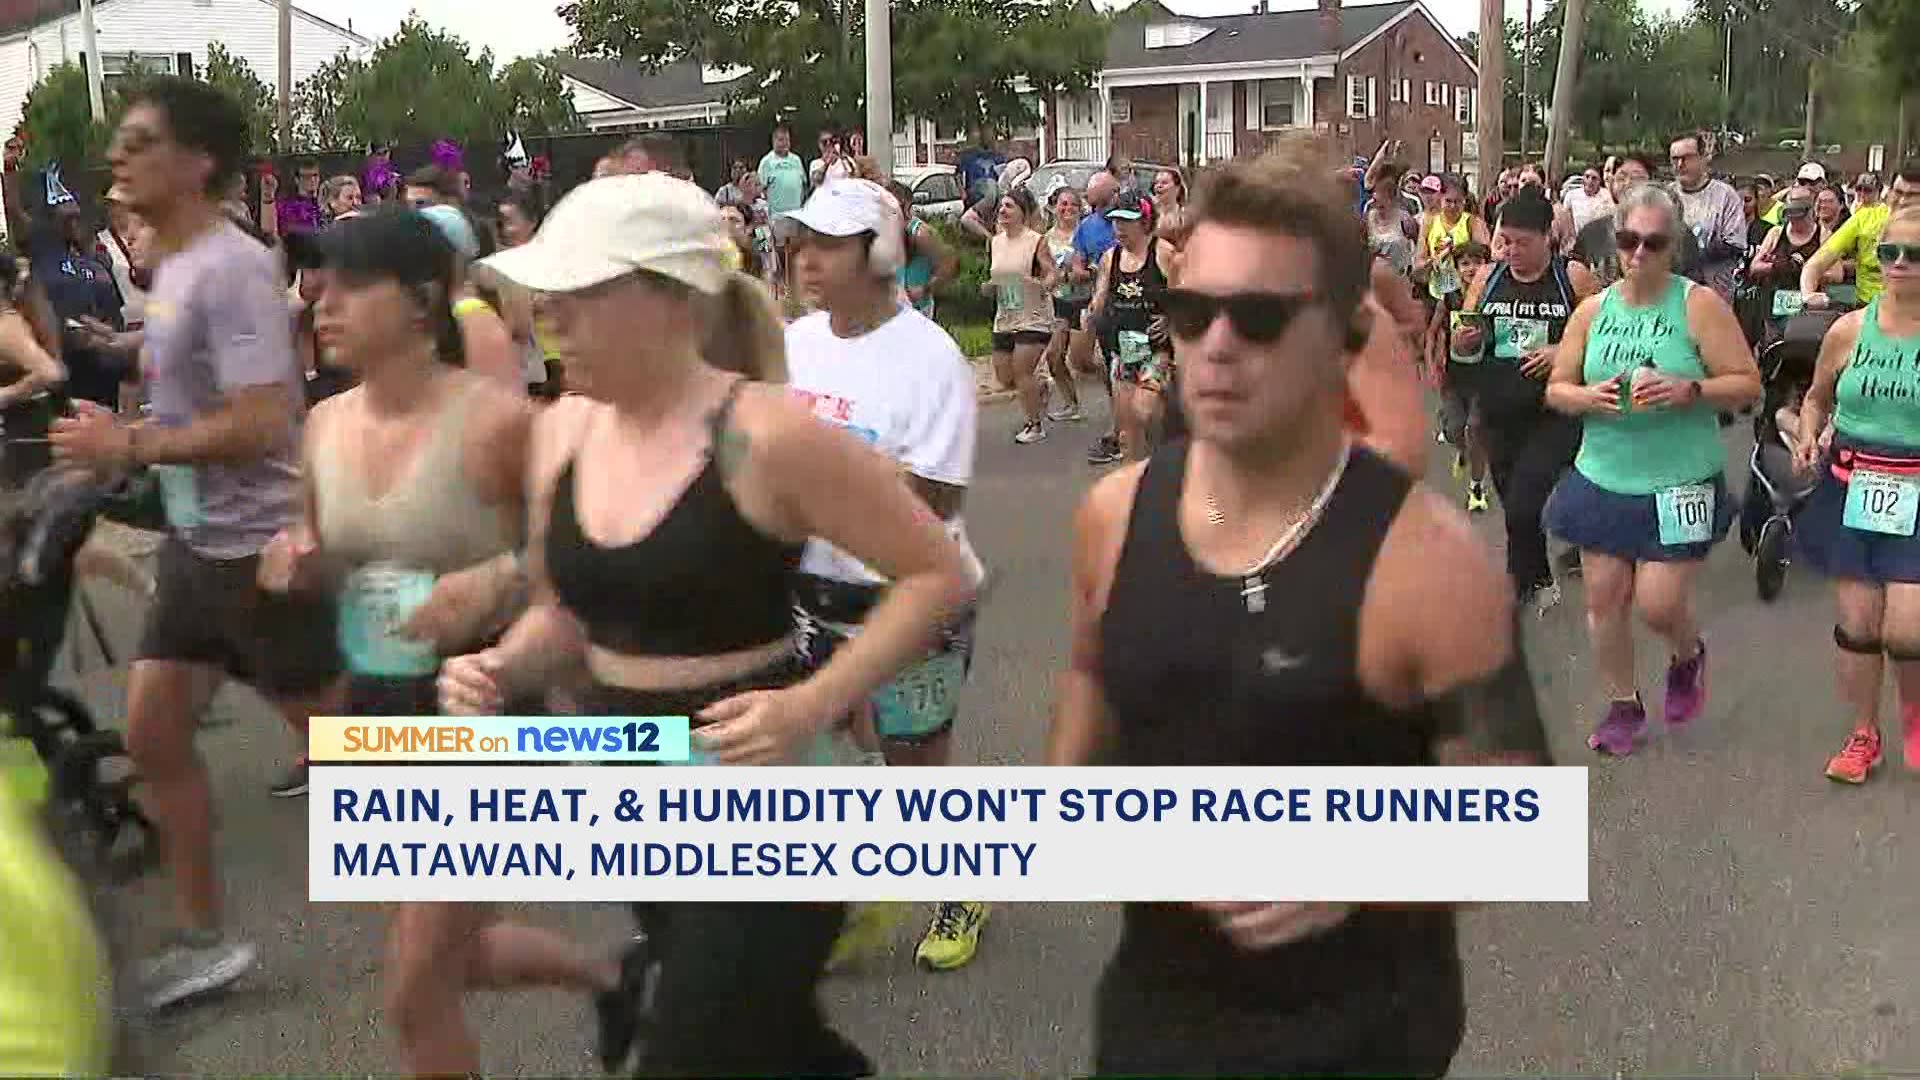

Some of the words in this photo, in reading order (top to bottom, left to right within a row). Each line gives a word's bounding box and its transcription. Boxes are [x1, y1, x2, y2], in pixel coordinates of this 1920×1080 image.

[1519, 304, 1535, 316] FIT
[1539, 303, 1566, 317] CLUB
[1676, 500, 1708, 526] 100
[1863, 489, 1899, 516] 102
